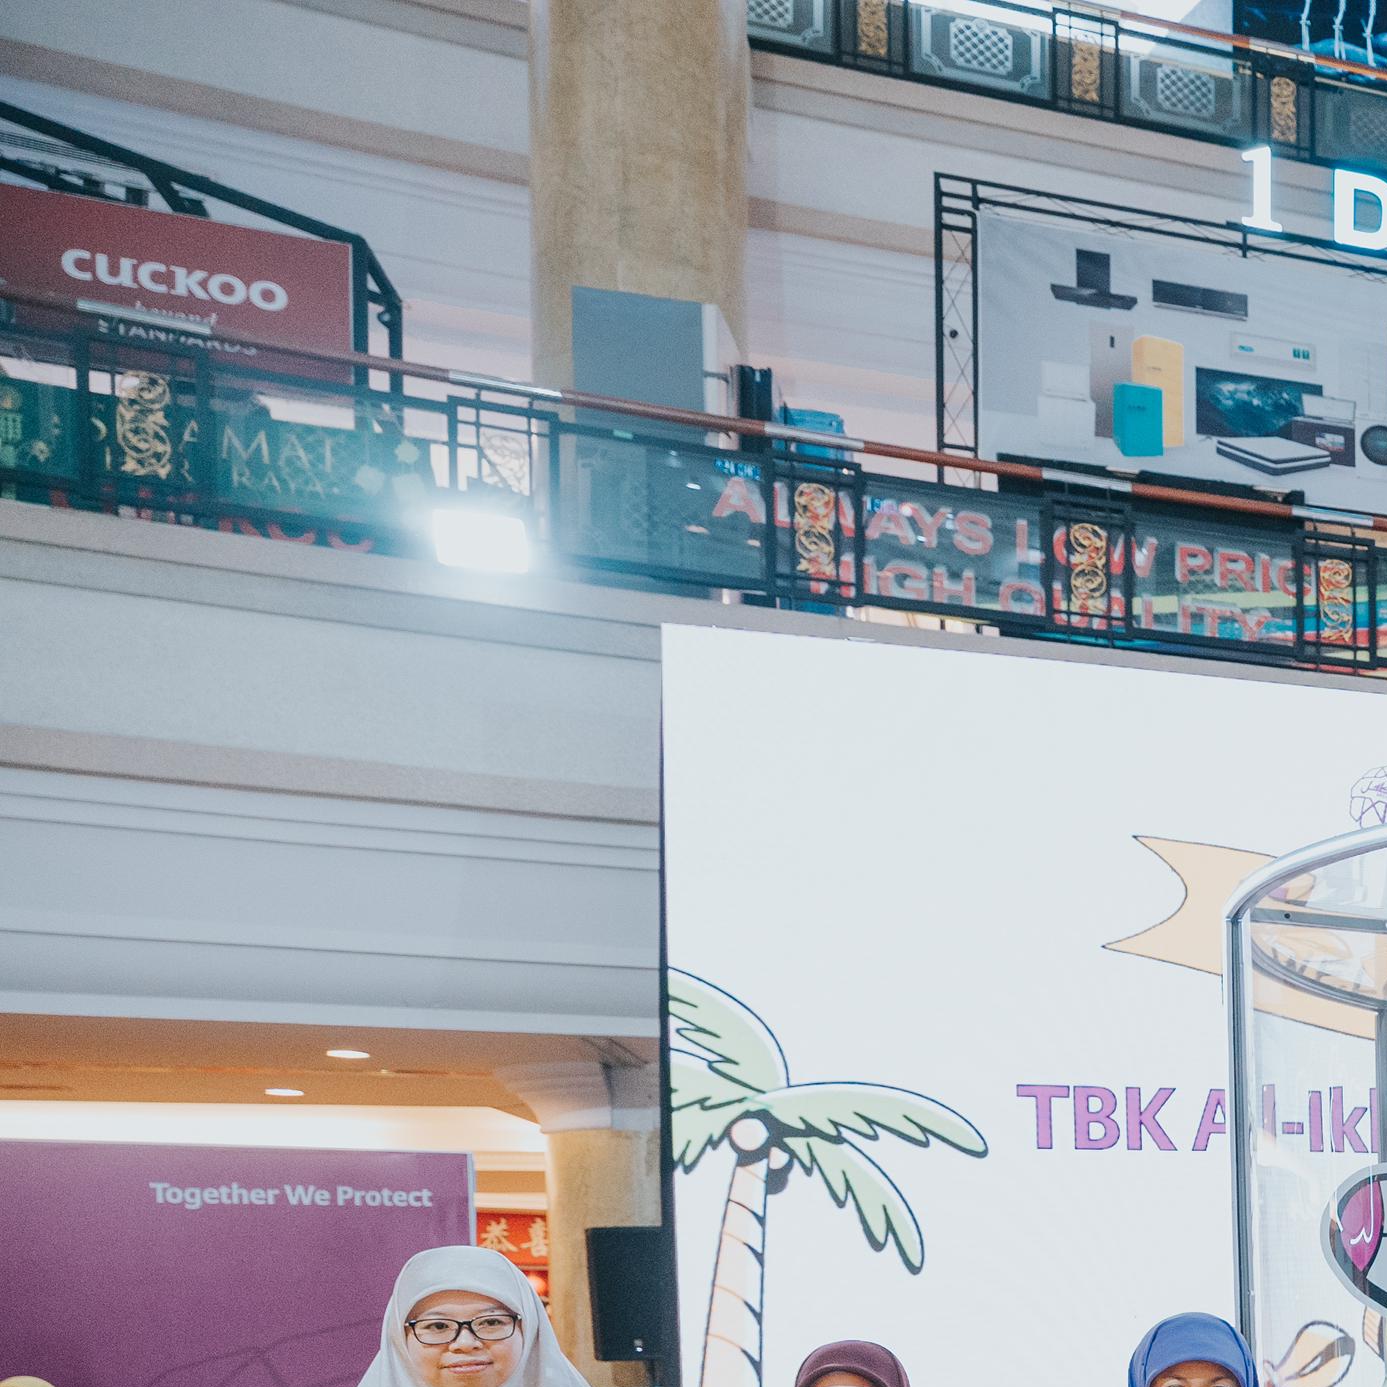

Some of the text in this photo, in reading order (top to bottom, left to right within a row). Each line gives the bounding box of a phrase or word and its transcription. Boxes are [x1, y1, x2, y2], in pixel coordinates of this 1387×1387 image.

[1241, 145, 1283, 232] 1
[61, 248, 289, 312] CUCKOO
[1016, 1083, 1178, 1152] TBK
[149, 1181, 433, 1211] Together We Protect
